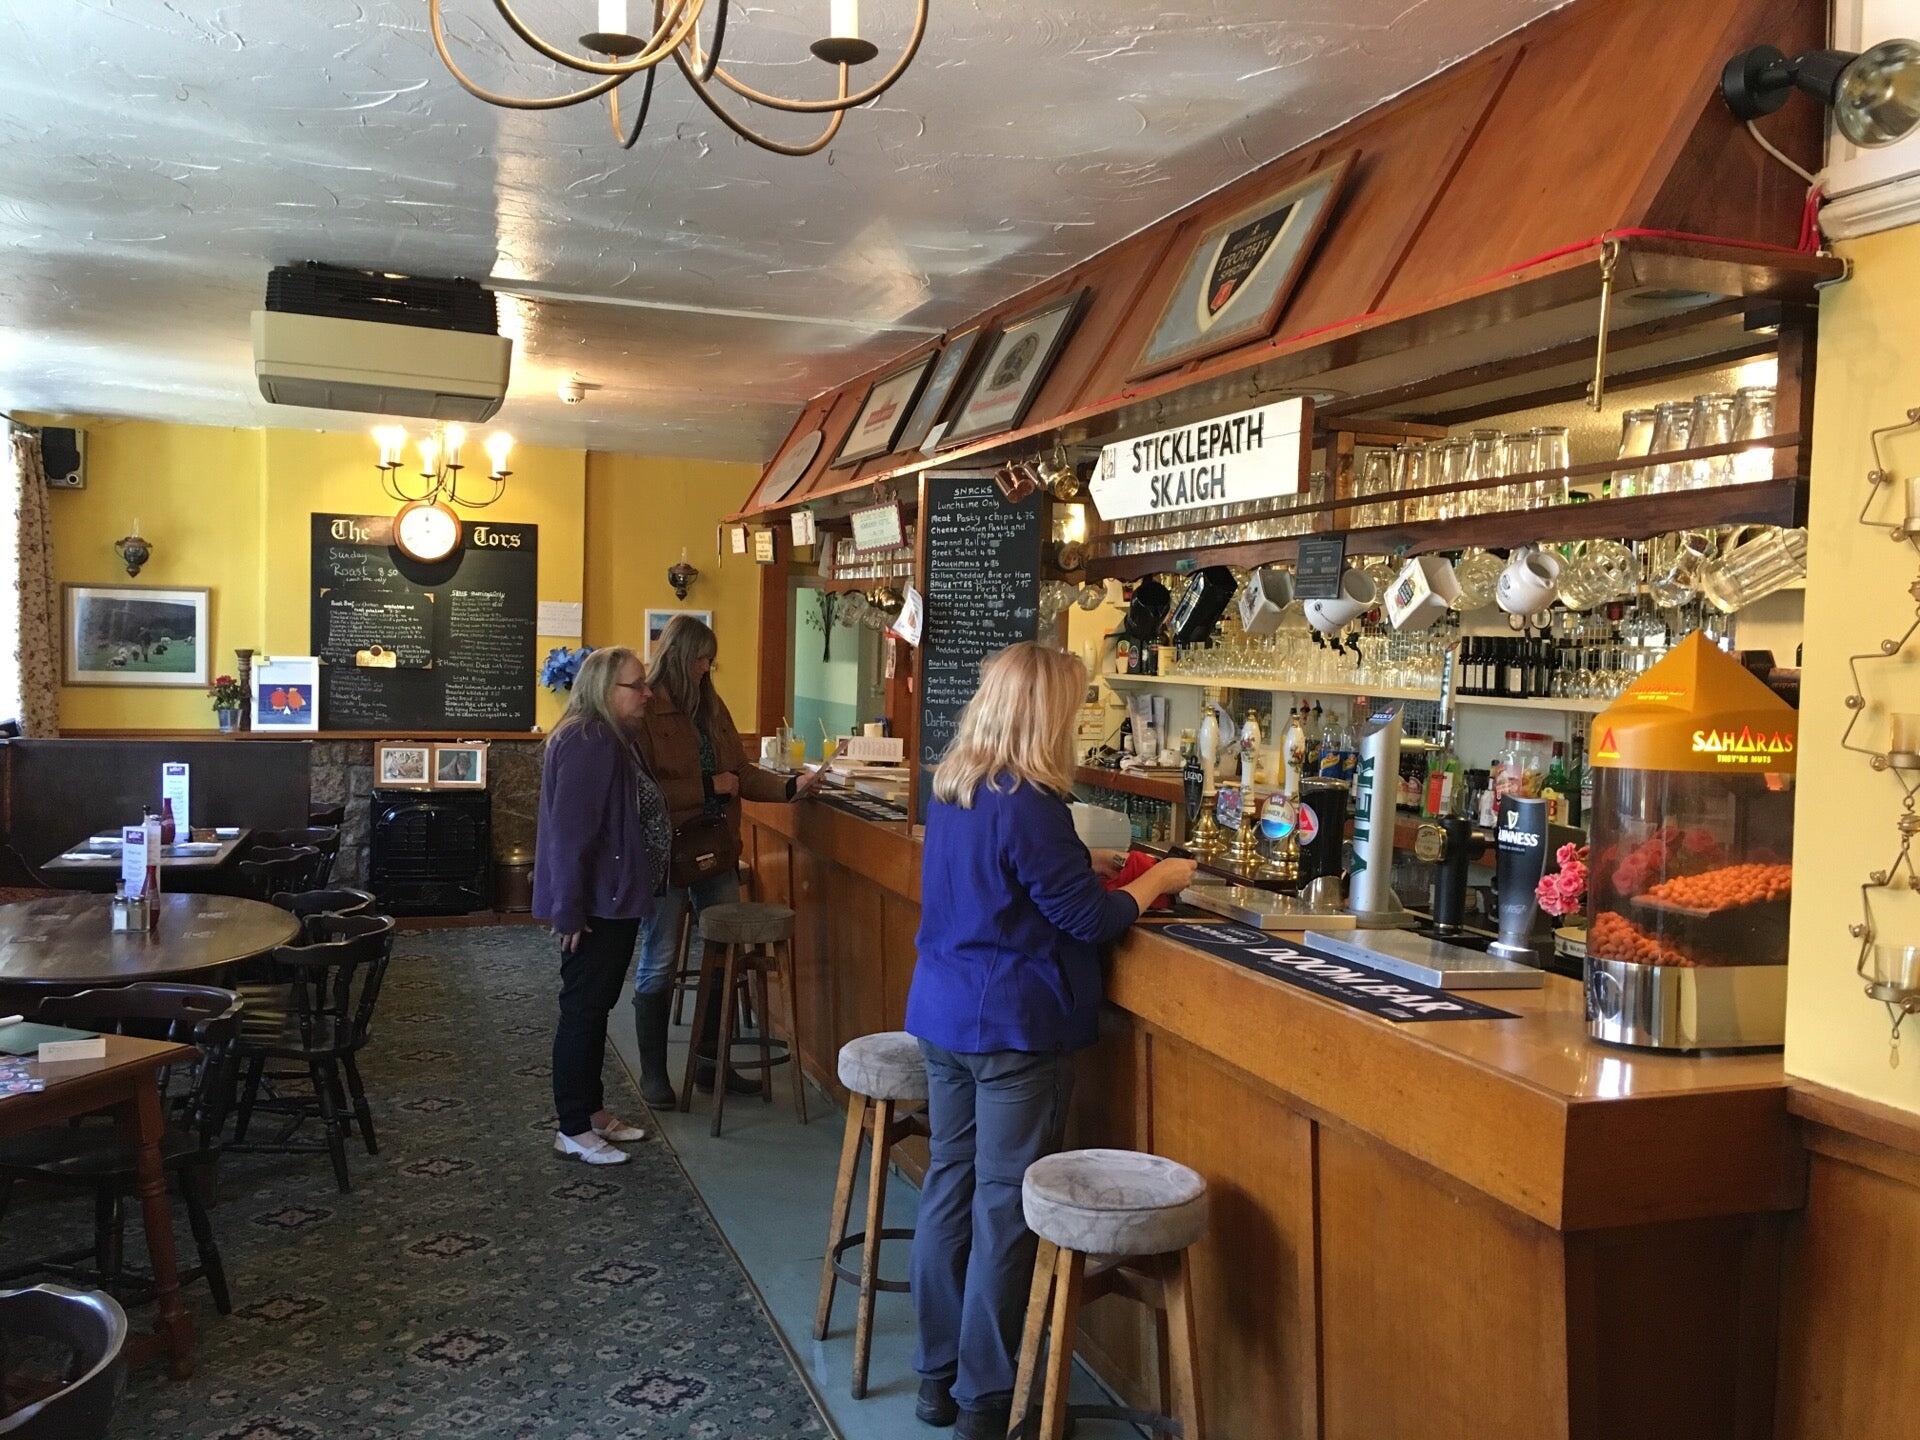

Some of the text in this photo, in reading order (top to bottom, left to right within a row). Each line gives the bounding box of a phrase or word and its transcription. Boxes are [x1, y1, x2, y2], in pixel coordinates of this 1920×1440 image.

[1218, 236, 1272, 270] TROPHY
[1132, 411, 1265, 474] STICKLEPATH
[954, 486, 992, 496] SNACKS
[1150, 464, 1226, 509] SKAIGH
[938, 499, 1000, 510] Lunchtime Only
[931, 514, 951, 523] Meat
[957, 514, 980, 526] Pasty
[989, 523, 1008, 531] Pasty
[331, 519, 521, 548] The Tors
[965, 538, 978, 546] Roll
[329, 547, 367, 564] Sunday
[955, 548, 977, 556] Salad
[330, 563, 368, 576] Roast
[976, 584, 997, 592] Pork
[994, 610, 1010, 619] Beef
[959, 628, 976, 636] chips
[958, 637, 979, 646] Salmon
[936, 646, 960, 654] Haddock
[928, 659, 958, 667] Available
[950, 676, 972, 685] Bread
[1691, 725, 1794, 752] SAHARAS
[1751, 755, 1772, 764] NUTS
[1184, 770, 1203, 783] LEGEND
[1243, 948, 1384, 984] DOOM
[1351, 984, 1464, 1014] BAR
